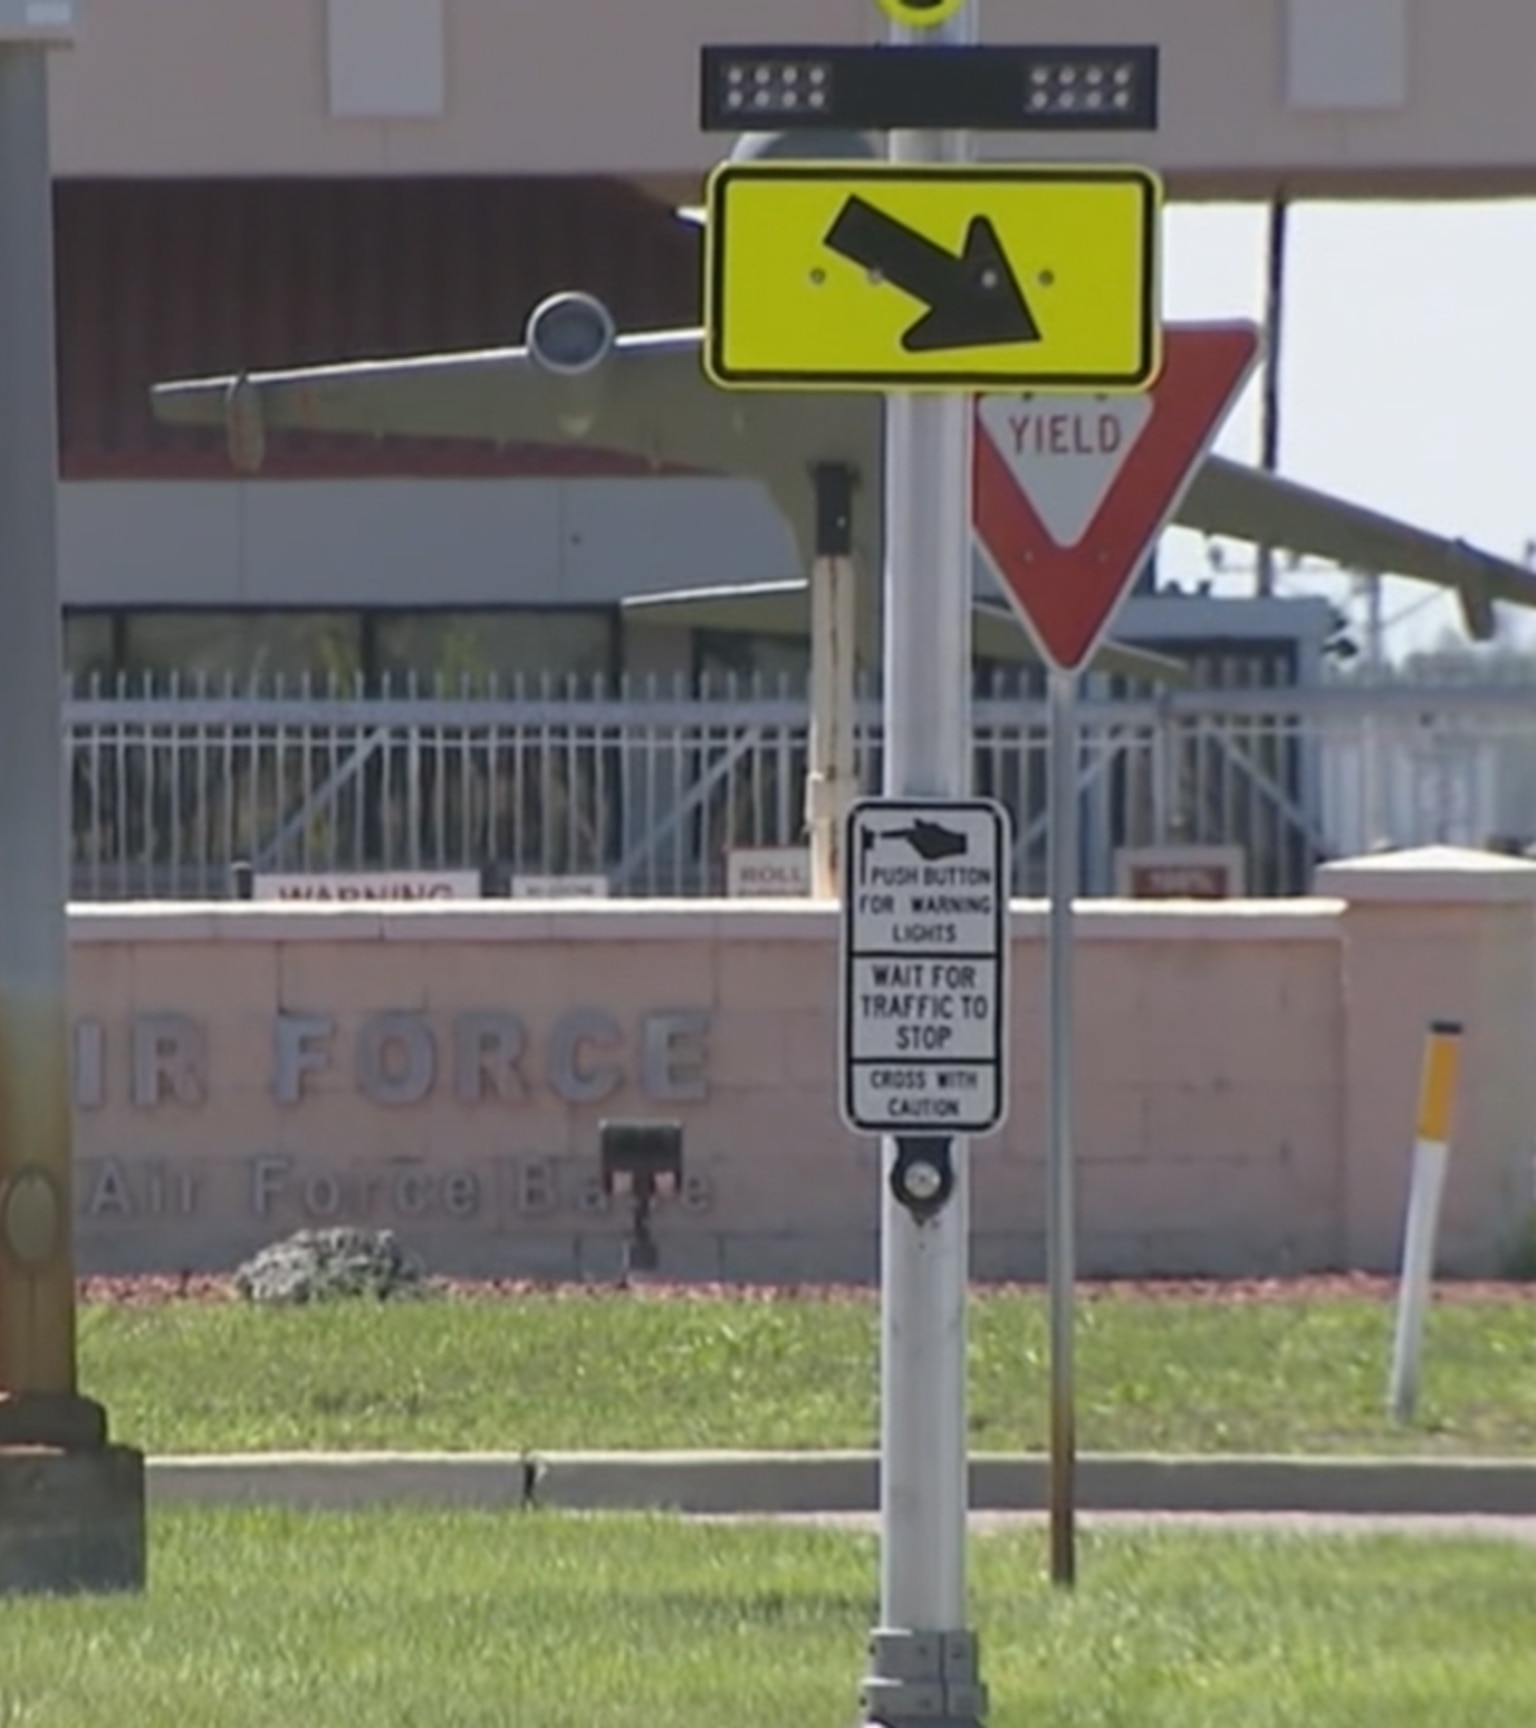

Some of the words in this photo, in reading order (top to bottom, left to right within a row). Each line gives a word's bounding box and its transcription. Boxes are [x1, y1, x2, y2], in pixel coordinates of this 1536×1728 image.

[1009, 413, 1121, 454] YIELD
[871, 866, 918, 886] PUSH
[923, 866, 991, 886] BUTTON
[860, 894, 894, 914] FOR
[911, 894, 991, 914] WARNING
[892, 922, 957, 943] LIGHTS
[872, 964, 923, 988] WAIT
[931, 964, 976, 989] FOR
[861, 994, 954, 1020] TRAFFIC
[961, 994, 989, 1020] TO
[896, 1024, 953, 1050] STOP
[272, 1010, 712, 1104] FORCE
[870, 1069, 927, 1089] CROSS
[937, 1070, 979, 1089] WITH
[888, 1097, 960, 1116] CAUTION
[89, 1156, 202, 1218] Air
[251, 1156, 480, 1216] Force
[516, 1156, 713, 1216] Bae
